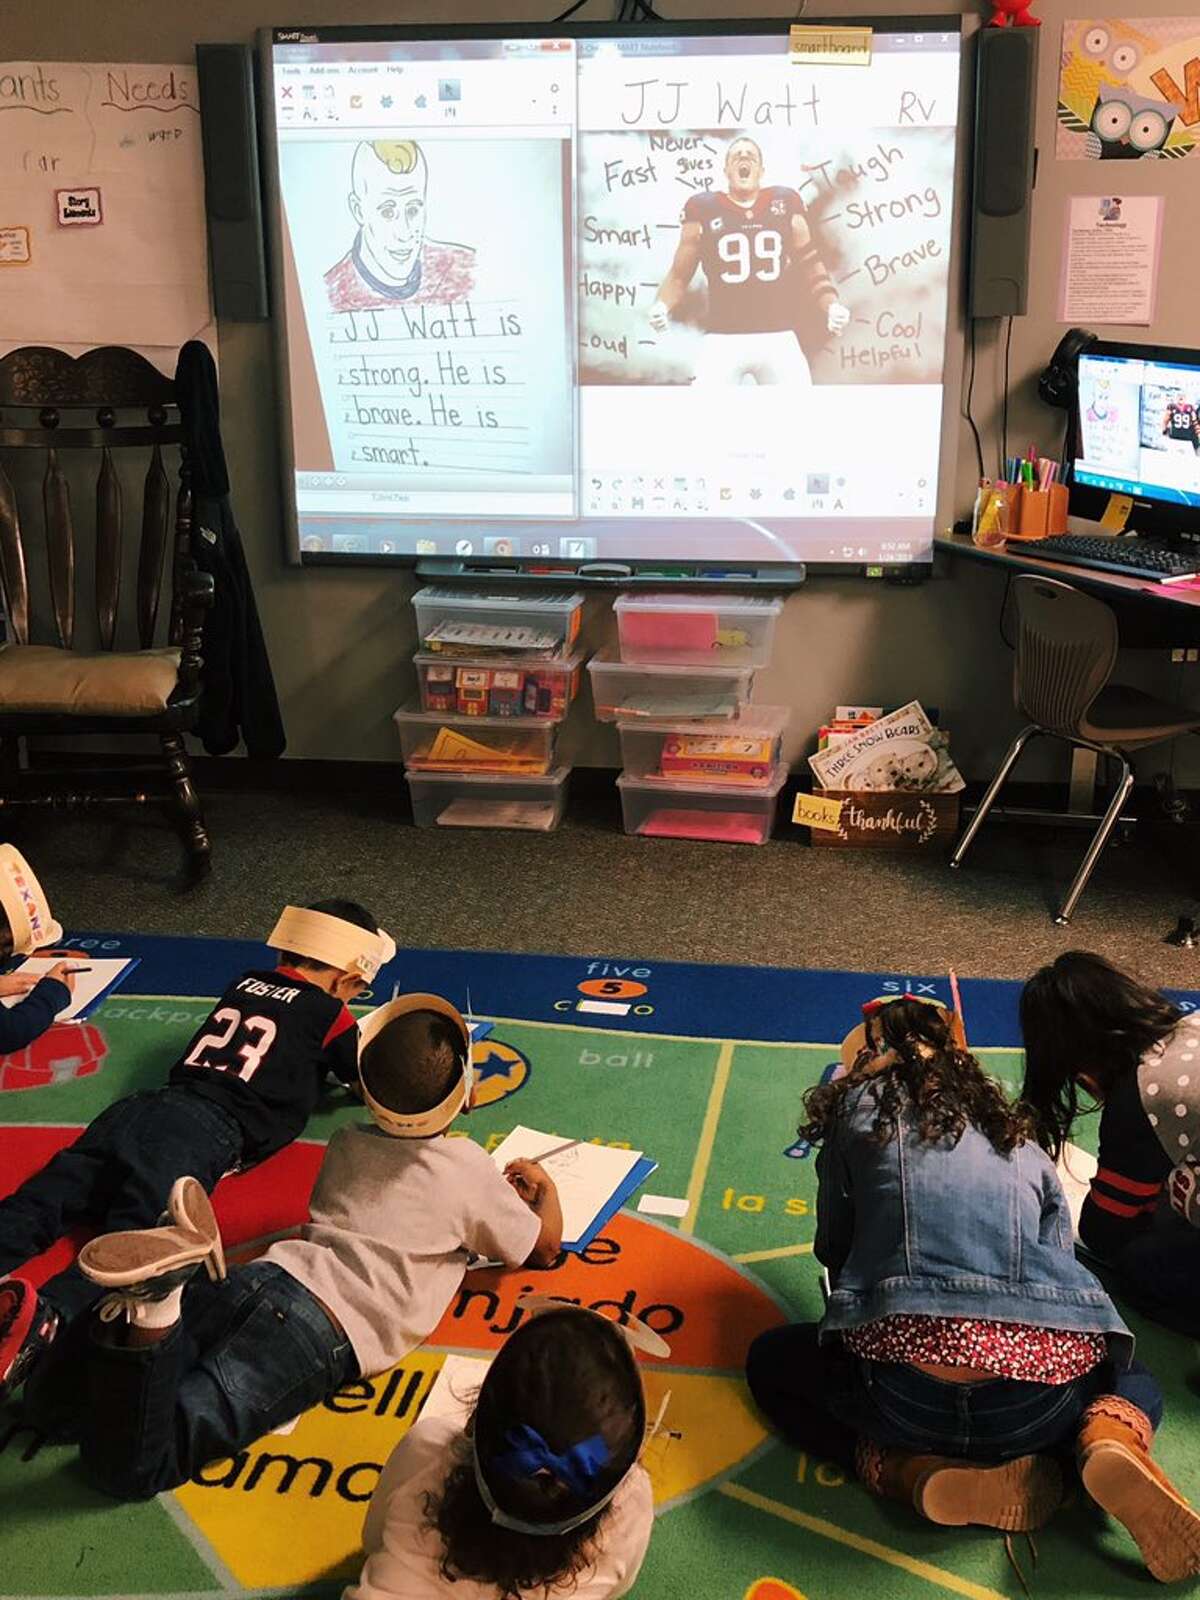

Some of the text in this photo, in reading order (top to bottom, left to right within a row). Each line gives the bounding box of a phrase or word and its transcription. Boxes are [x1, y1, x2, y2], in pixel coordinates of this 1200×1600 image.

[794, 35, 867, 53] smartboard
[0, 66, 188, 101] ants Needs
[387, 66, 403, 74] Help
[621, 79, 936, 126] JJ Watt RV
[650, 135, 703, 151] Never
[604, 156, 657, 192] Fast
[676, 157, 713, 174] gives
[812, 144, 904, 189] Tough
[693, 175, 714, 192] up
[846, 186, 942, 229] Strong
[583, 215, 651, 249] Smart
[718, 230, 783, 283] 99
[864, 239, 942, 286] Brave
[341, 301, 522, 341] JJ Watt is
[876, 311, 922, 339] Cool
[841, 342, 922, 368] Helpful
[349, 351, 507, 397] strong. He is
[354, 393, 499, 429] brave. He is
[1173, 413, 1190, 429] 99
[362, 438, 429, 467] smart.
[826, 725, 920, 779] THREE SNOW BEARS
[798, 803, 836, 824] books
[841, 805, 924, 834] thankful
[63, 937, 121, 950] ree
[586, 961, 652, 978] five
[236, 977, 300, 1003] FOSTER
[598, 982, 622, 994] 5
[881, 980, 937, 995] six
[184, 1008, 277, 1083] 23
[578, 1050, 654, 1069] ball
[722, 1187, 765, 1212] la
